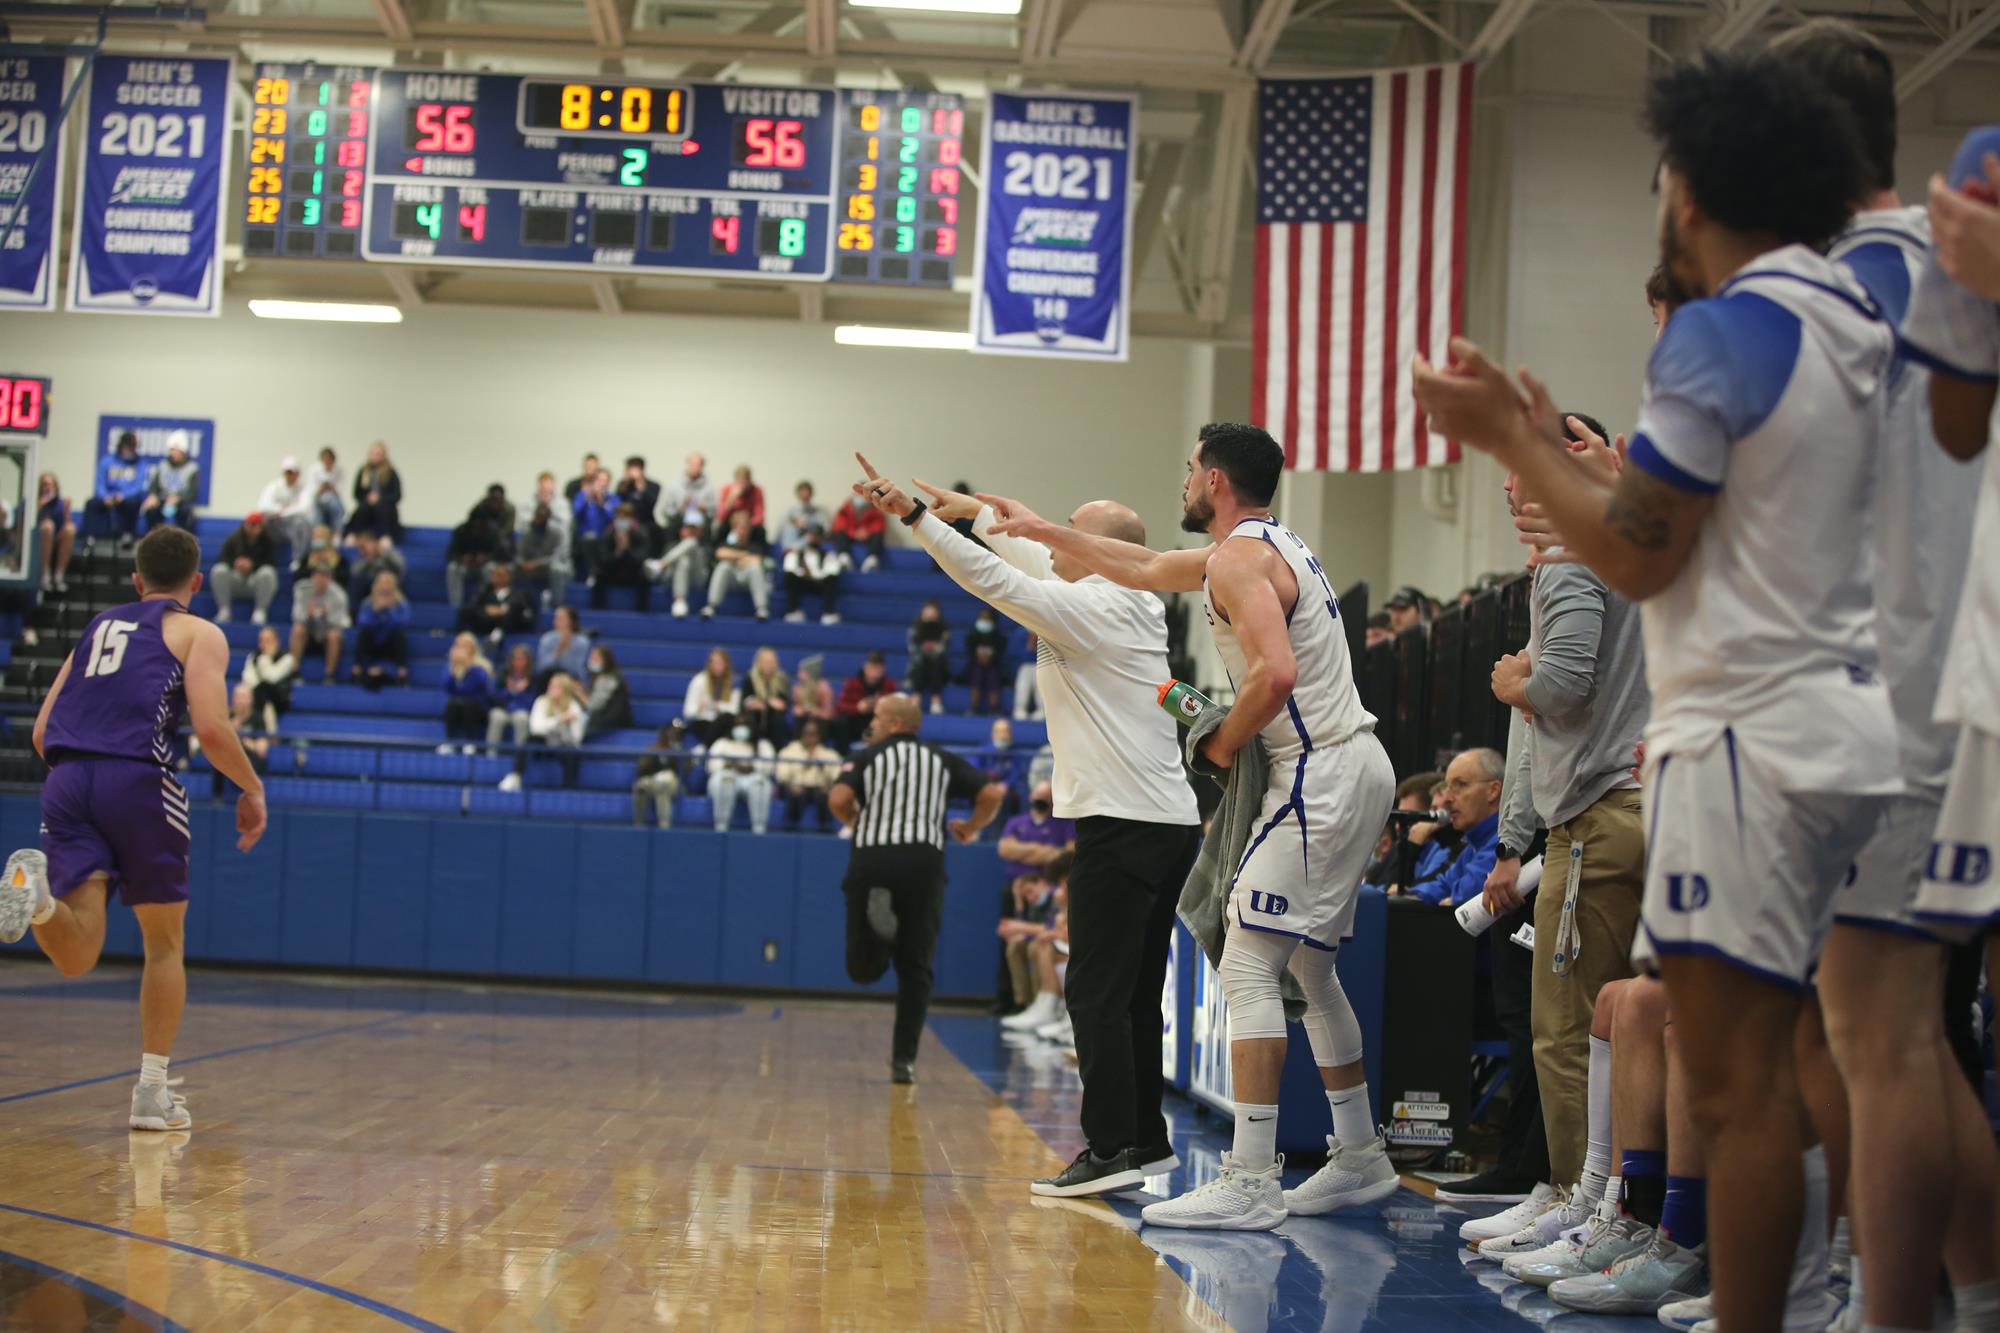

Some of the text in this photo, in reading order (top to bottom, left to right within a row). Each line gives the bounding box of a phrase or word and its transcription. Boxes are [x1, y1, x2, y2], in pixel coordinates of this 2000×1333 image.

[128, 62, 194, 83] MEN'S
[116, 84, 202, 107] SOCCER
[255, 77, 369, 108] 20 1 2
[405, 75, 479, 101] HOME
[722, 88, 821, 117] VISITOR
[252, 107, 367, 138] 23 0 3
[560, 84, 682, 134] 8:01
[860, 104, 963, 135] 0 0 11
[1026, 102, 1096, 125] MEN'S
[100, 112, 206, 158] 2021
[415, 104, 475, 153] 56
[744, 119, 806, 168] 56
[993, 121, 1127, 149] BASKETBALL
[250, 137, 366, 167] 24 1 13
[557, 153, 617, 173] PERIOD
[867, 135, 961, 165] 1 2 0
[422, 156, 476, 177] BONUS
[620, 148, 648, 186] 2
[728, 170, 783, 190] BONUS
[858, 164, 959, 195] 3 2 19
[1004, 151, 1111, 201] 2021
[248, 167, 363, 197] 25 1 2
[247, 196, 361, 227] 32 3 3
[518, 189, 700, 214] PLAYER POINTS FOULS
[848, 194, 958, 224] 15 0 7
[416, 203, 486, 241] 4 4
[712, 216, 806, 256] 4 8
[838, 223, 957, 256] 25 3 3
[84, 619, 138, 678] 15
[1250, 889, 1289, 916] UD
